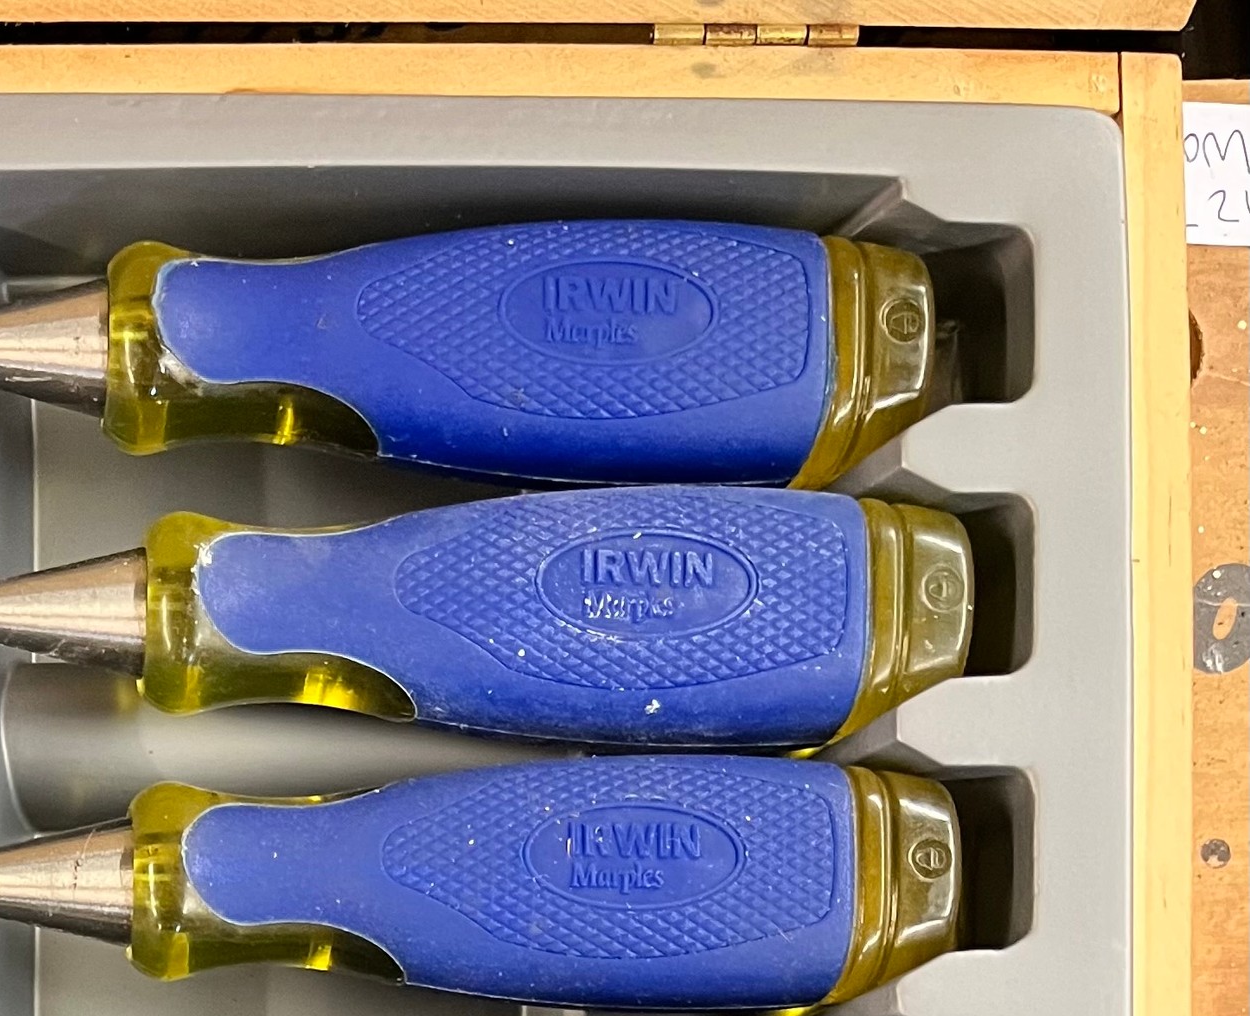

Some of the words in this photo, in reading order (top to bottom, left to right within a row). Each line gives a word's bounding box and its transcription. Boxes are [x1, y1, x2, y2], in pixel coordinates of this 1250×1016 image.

[542, 275, 678, 315] IRWIN
[546, 318, 639, 349] Marples
[581, 548, 715, 587] IRWIN
[567, 821, 702, 860] IRWIN
[570, 862, 665, 895] Marples
